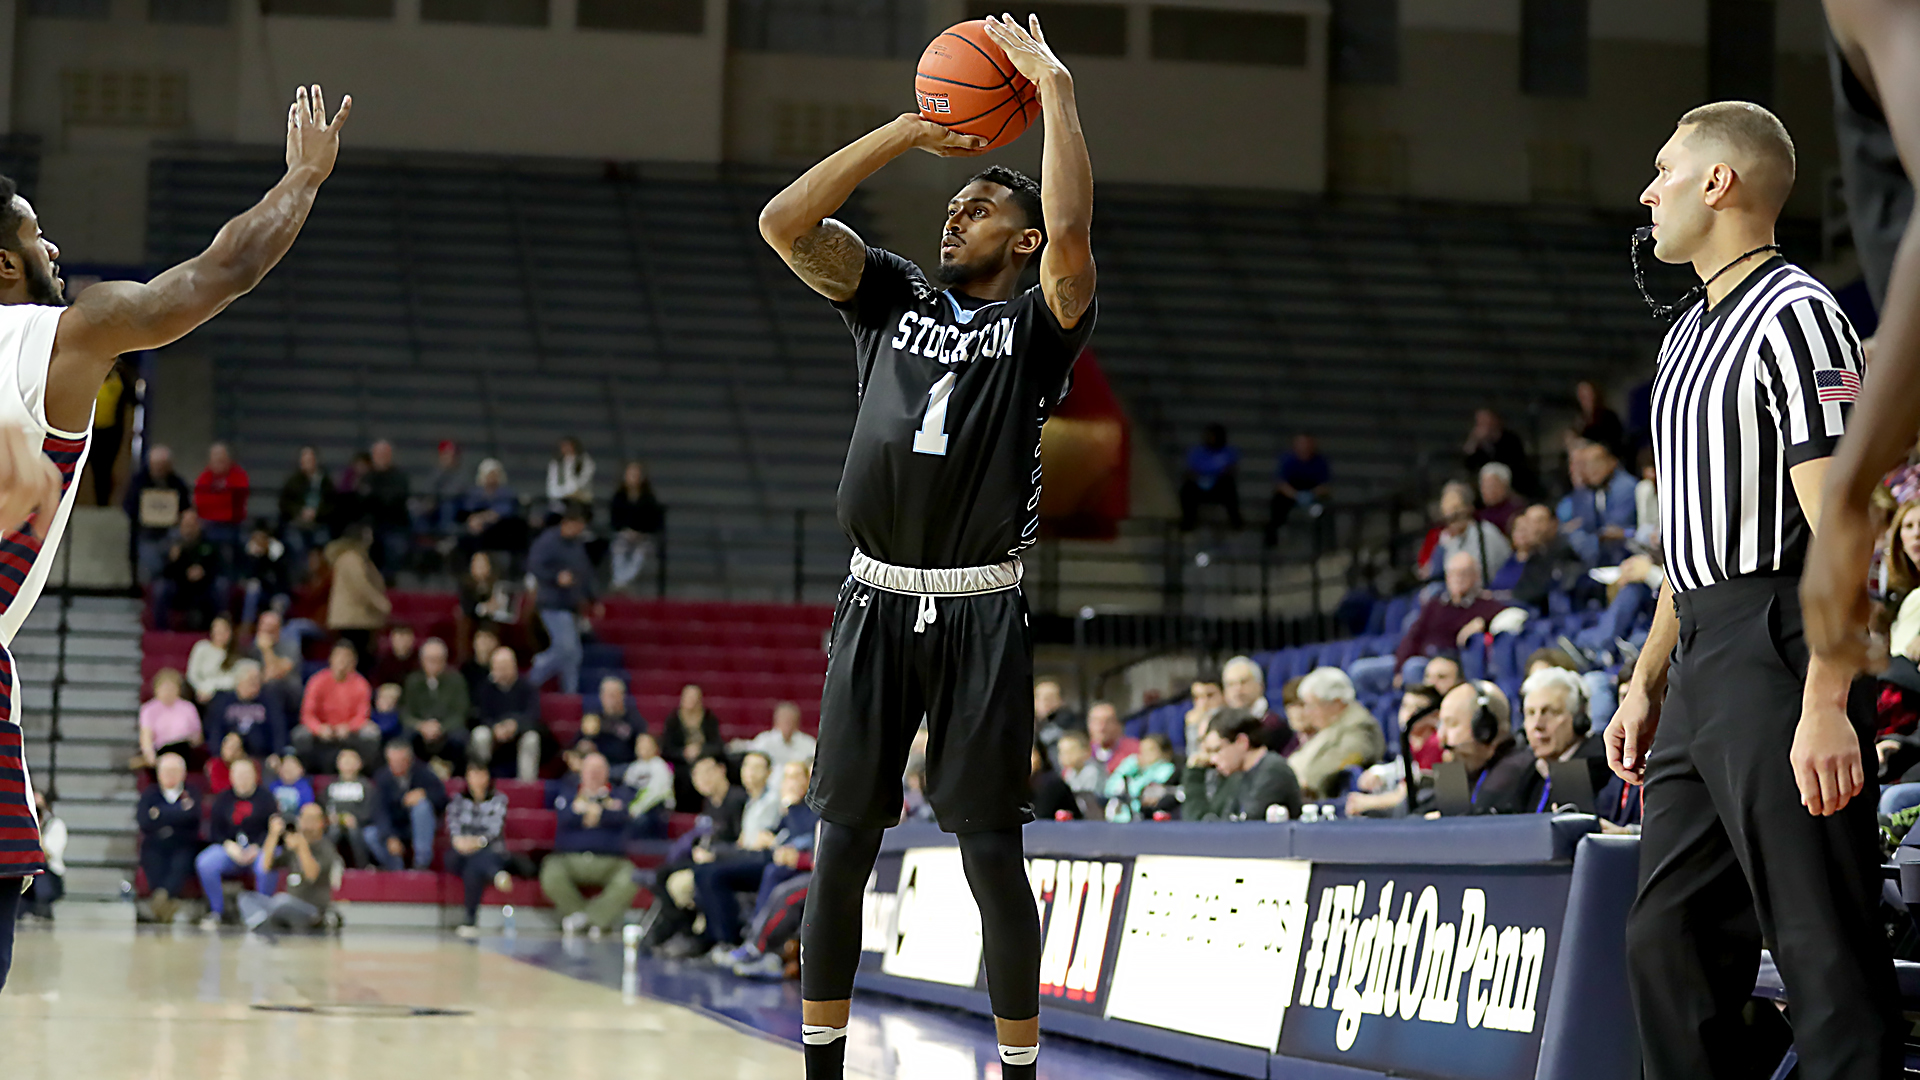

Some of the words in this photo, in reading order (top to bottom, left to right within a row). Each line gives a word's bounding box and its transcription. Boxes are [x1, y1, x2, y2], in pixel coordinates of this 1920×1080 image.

[892, 311, 1017, 364] STOCKTON
[913, 371, 957, 455] 1
[1299, 880, 1546, 1051] #FightOnPenn
